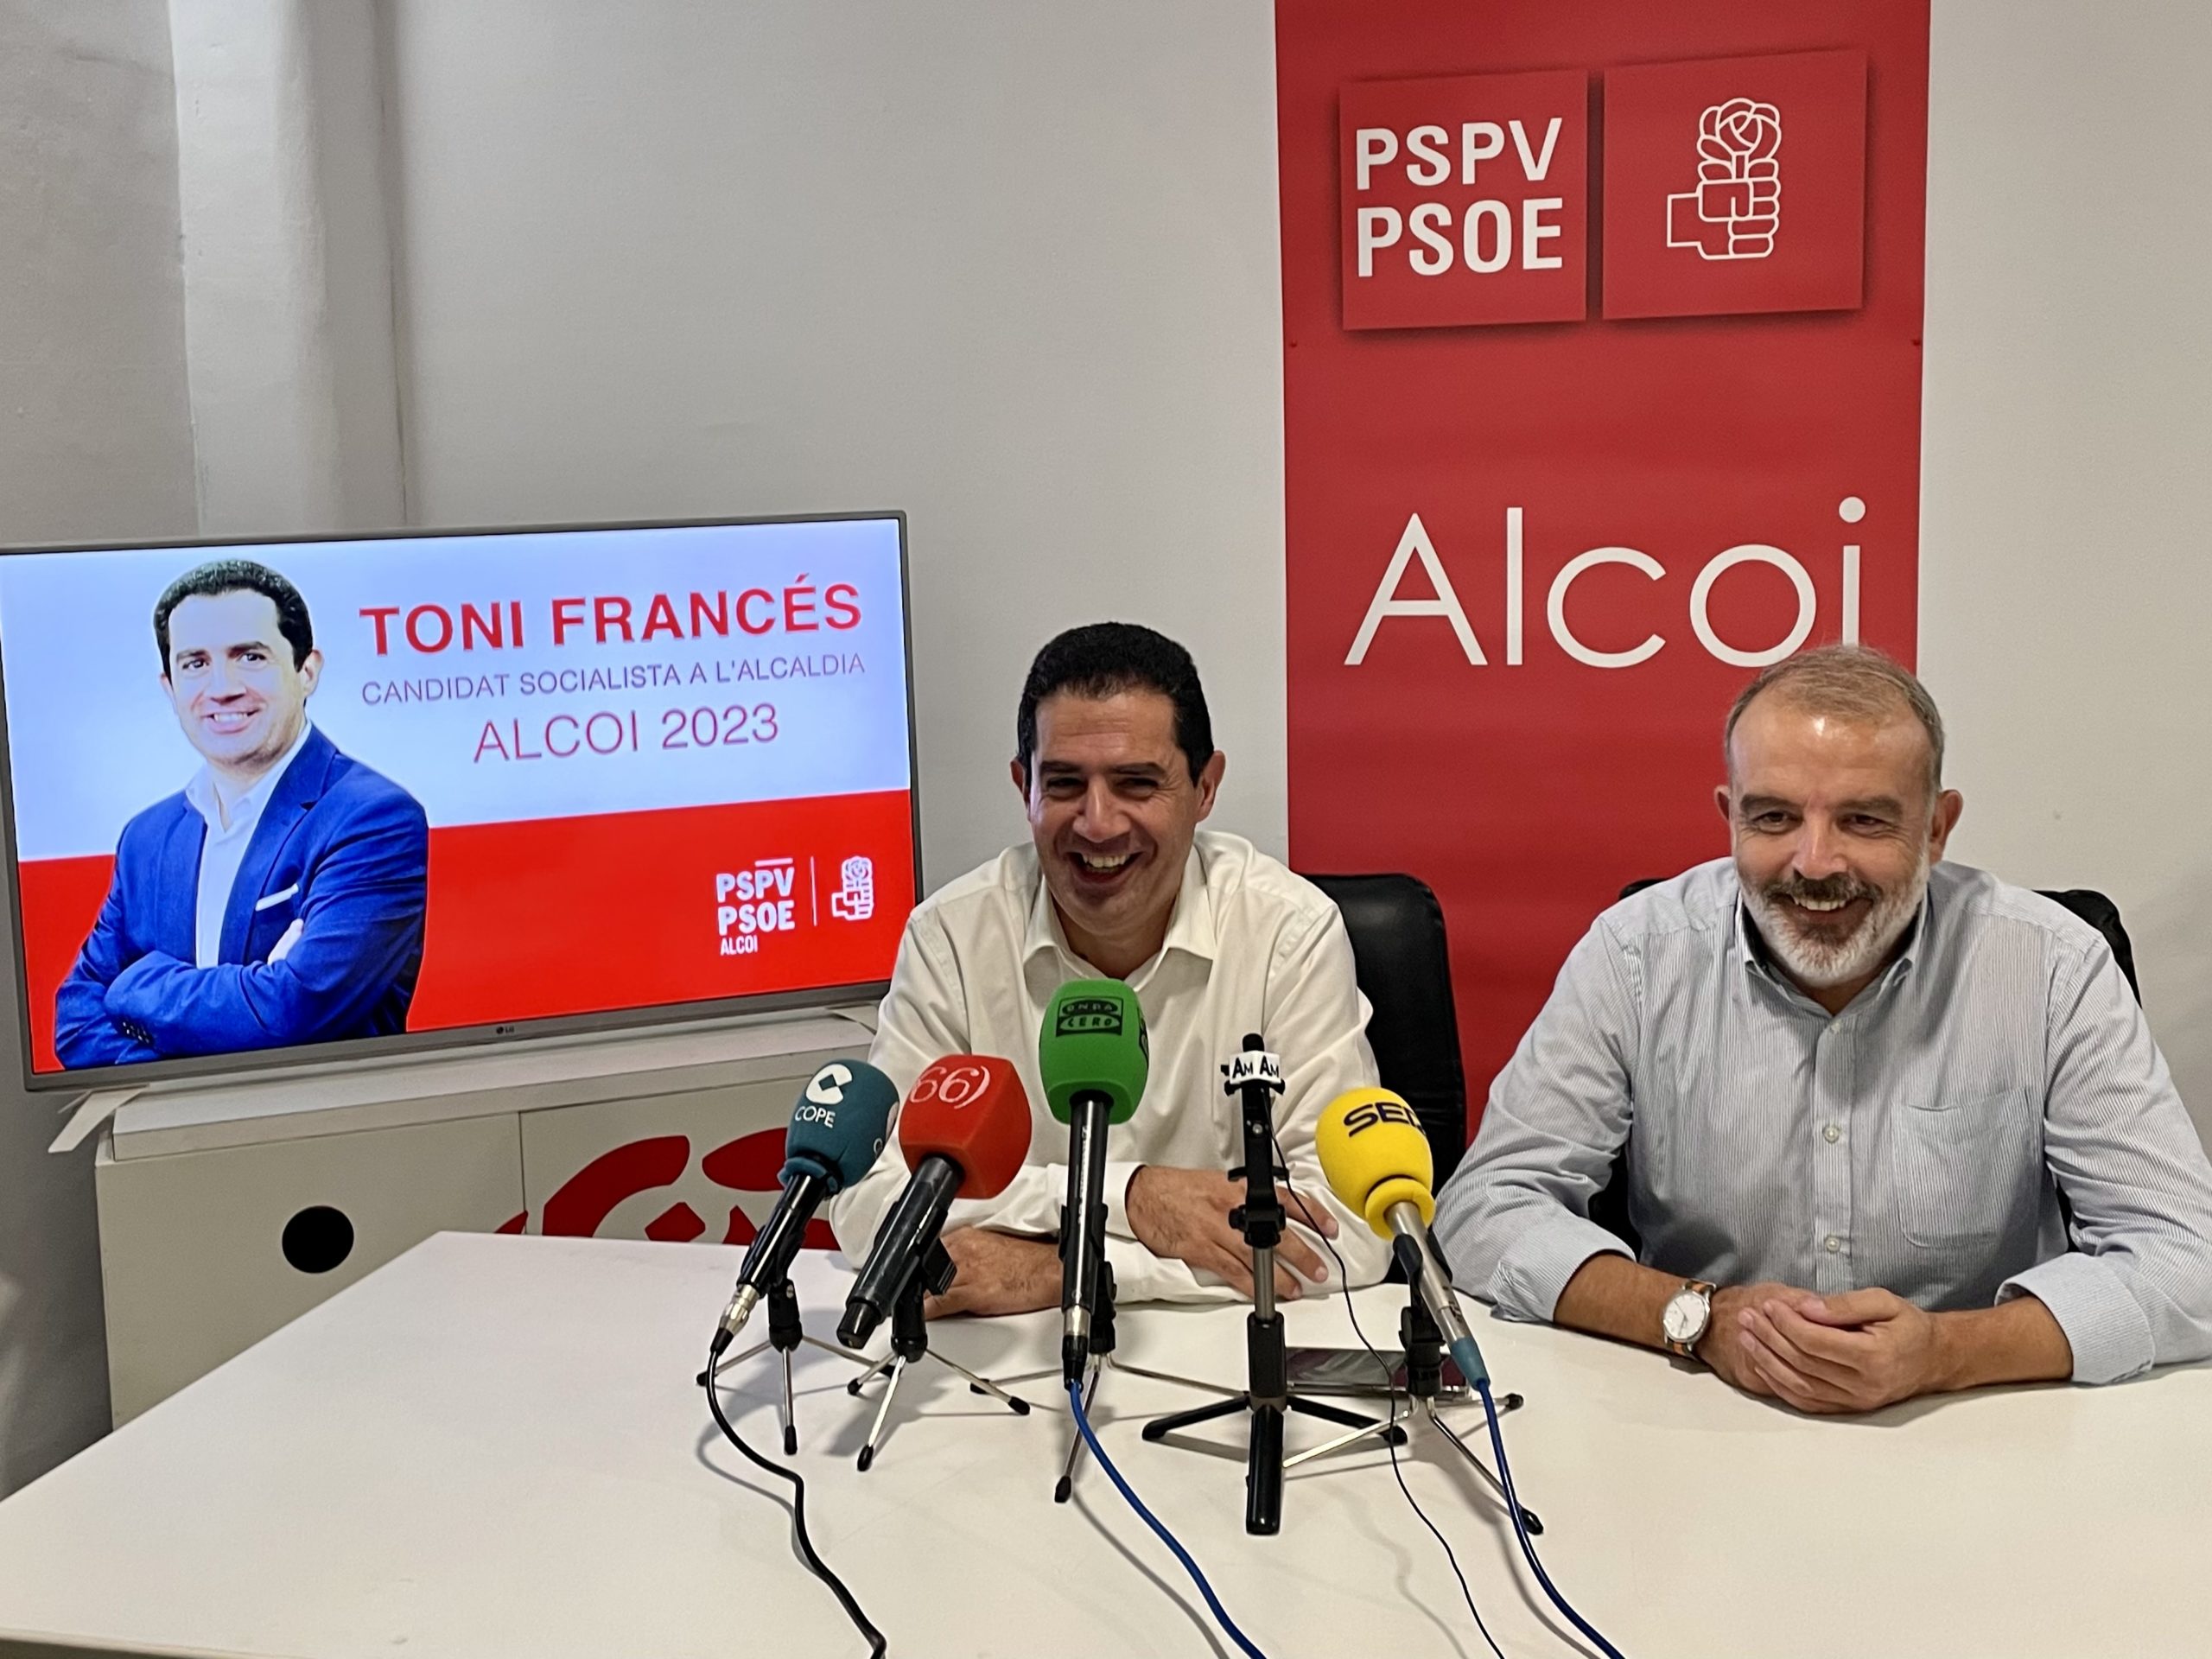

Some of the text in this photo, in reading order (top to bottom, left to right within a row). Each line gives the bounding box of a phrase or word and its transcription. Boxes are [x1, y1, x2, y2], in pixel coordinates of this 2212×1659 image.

[1356, 117, 1563, 191] PSPV
[1357, 197, 1563, 277] PSOE
[1344, 496, 1866, 669] Alcoi
[359, 572, 861, 657] TONI FRANCÉS
[361, 652, 866, 706] CANDIDAT SOCIALISTA A L'ALCALDIA
[474, 702, 779, 764] ALCOI 2023
[715, 867, 796, 903] PSPV
[717, 899, 796, 936] PSOE
[719, 934, 759, 957] ALCOI
[794, 1105, 836, 1128] COPE
